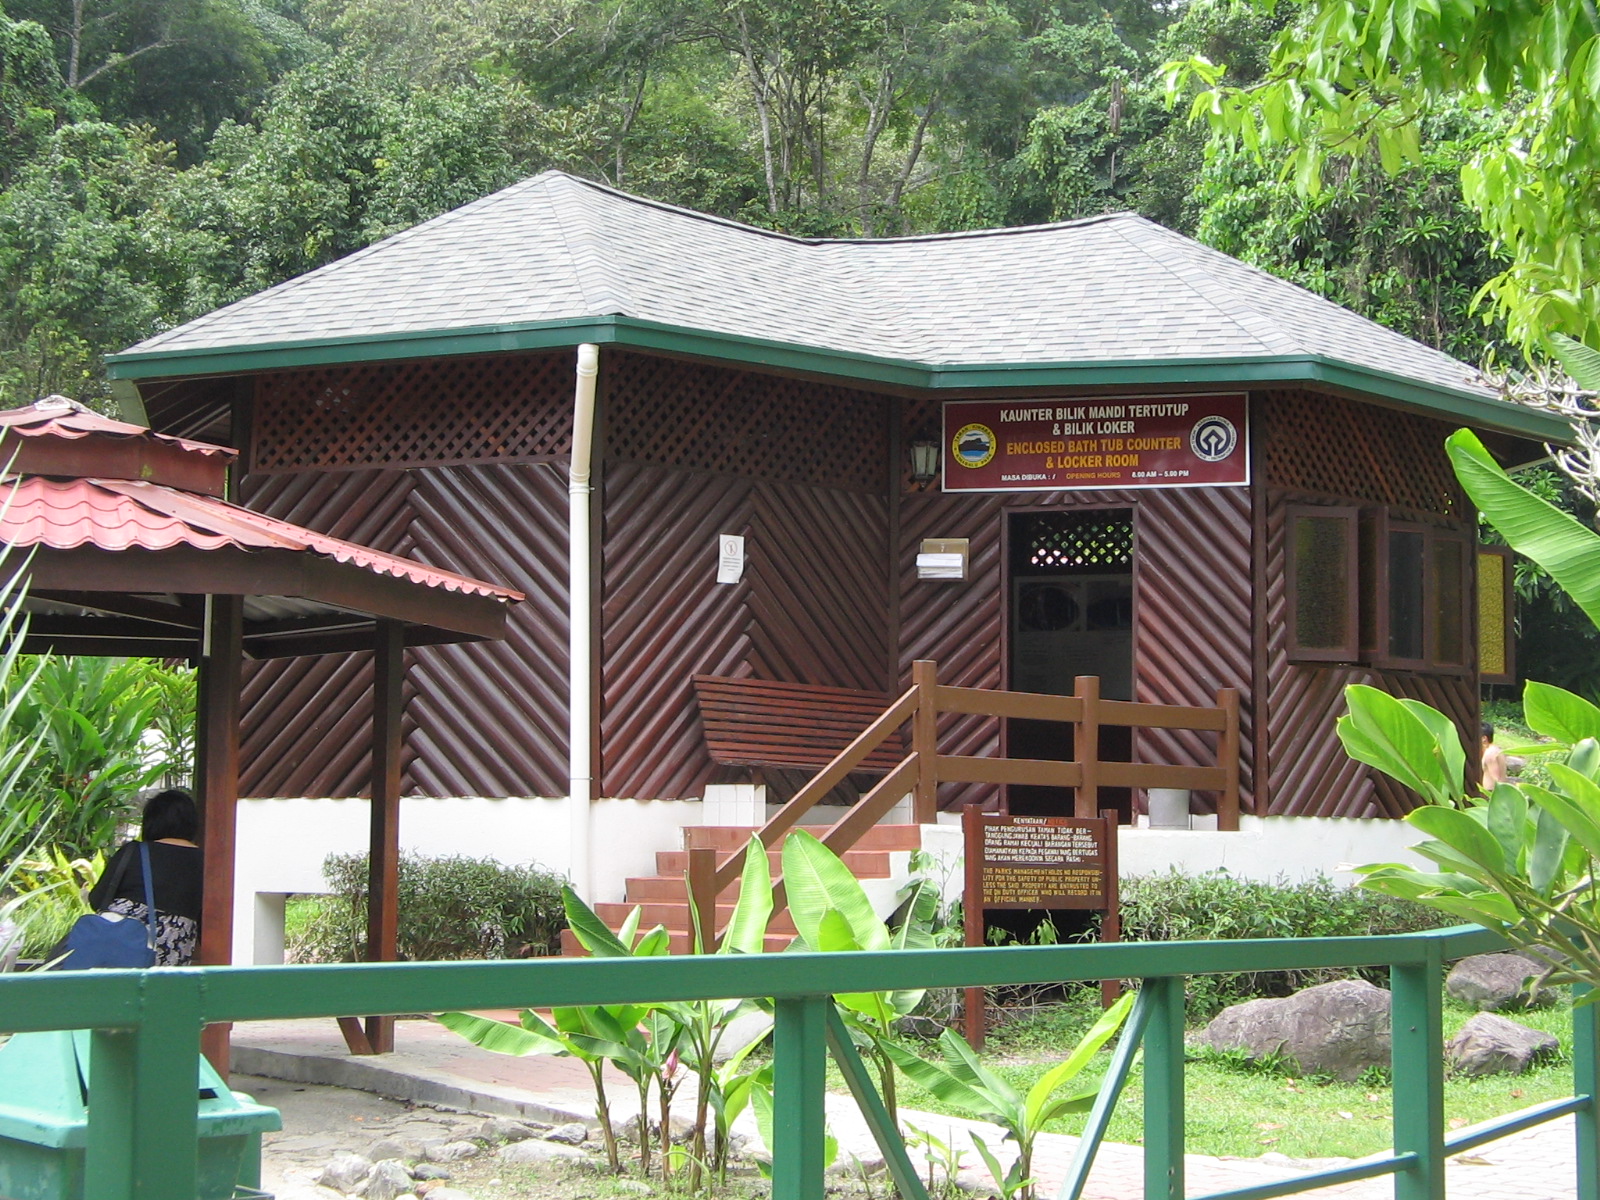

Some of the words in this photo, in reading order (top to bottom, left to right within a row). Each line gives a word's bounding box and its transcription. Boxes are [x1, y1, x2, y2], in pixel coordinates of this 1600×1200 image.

[1000, 408, 1052, 422] KAUNTER
[1056, 407, 1086, 420] BILIK
[1089, 406, 1125, 419] MANDI
[1128, 404, 1189, 418] TERTUTUP
[1052, 423, 1060, 435] &
[1064, 422, 1094, 435] BILIK
[1097, 421, 1135, 434] LOKER
[1006, 441, 1065, 455] ENCLOSED
[1068, 440, 1098, 453] BATH
[1101, 438, 1123, 451] TUB
[1127, 437, 1181, 450] COUNTER
[1046, 456, 1054, 468] &
[1058, 455, 1102, 468] LOCKER
[1106, 454, 1138, 467] ROOM
